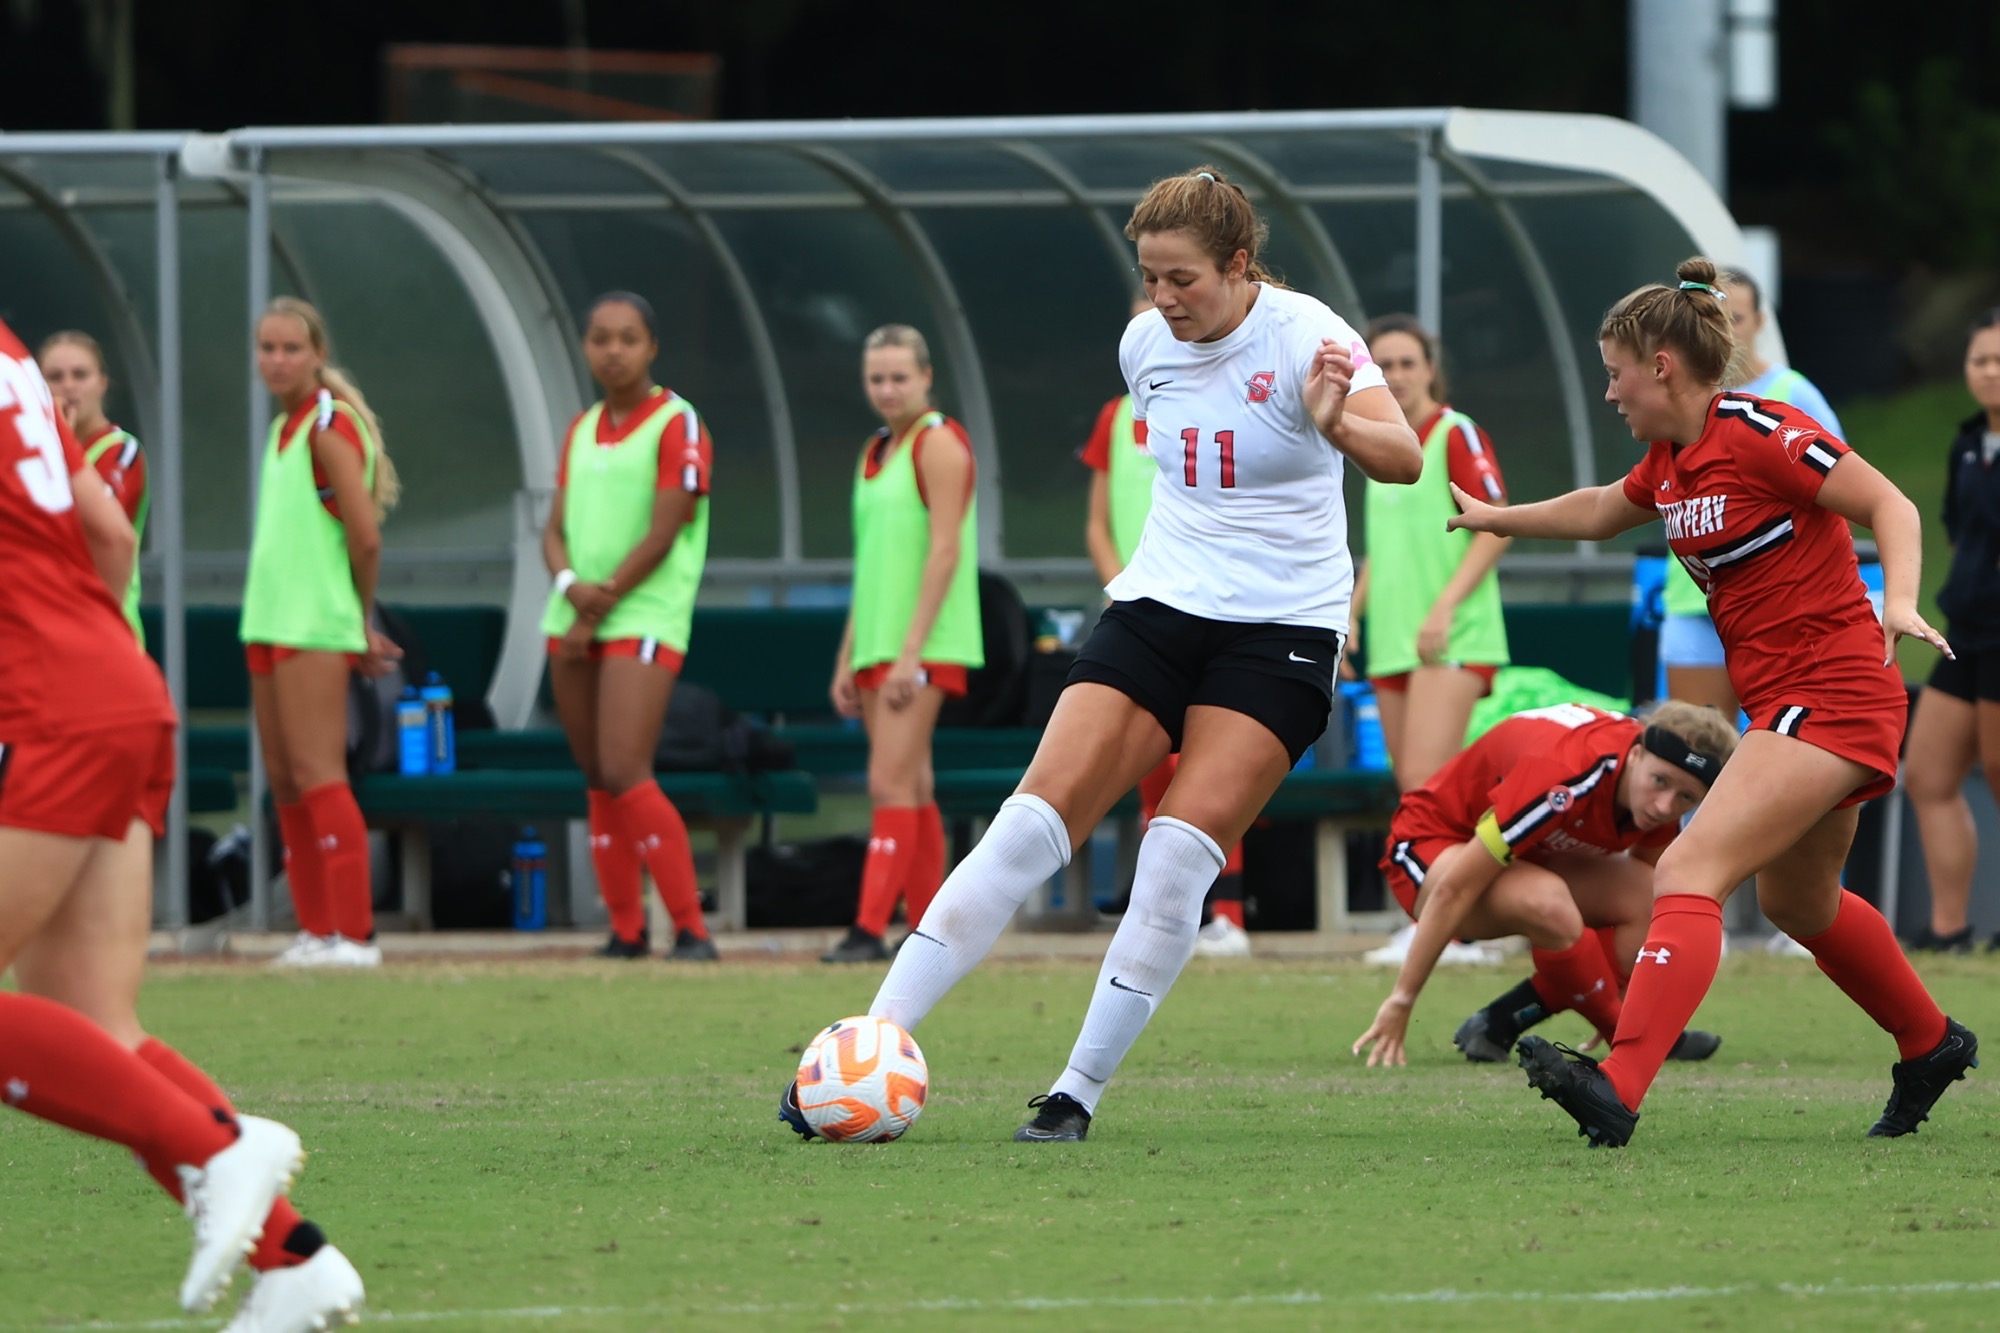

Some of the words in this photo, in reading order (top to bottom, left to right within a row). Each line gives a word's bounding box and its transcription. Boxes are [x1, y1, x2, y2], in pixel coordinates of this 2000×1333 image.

[0, 352, 75, 514] 3
[1181, 427, 1235, 488] 11
[1684, 494, 1728, 539] PEAY
